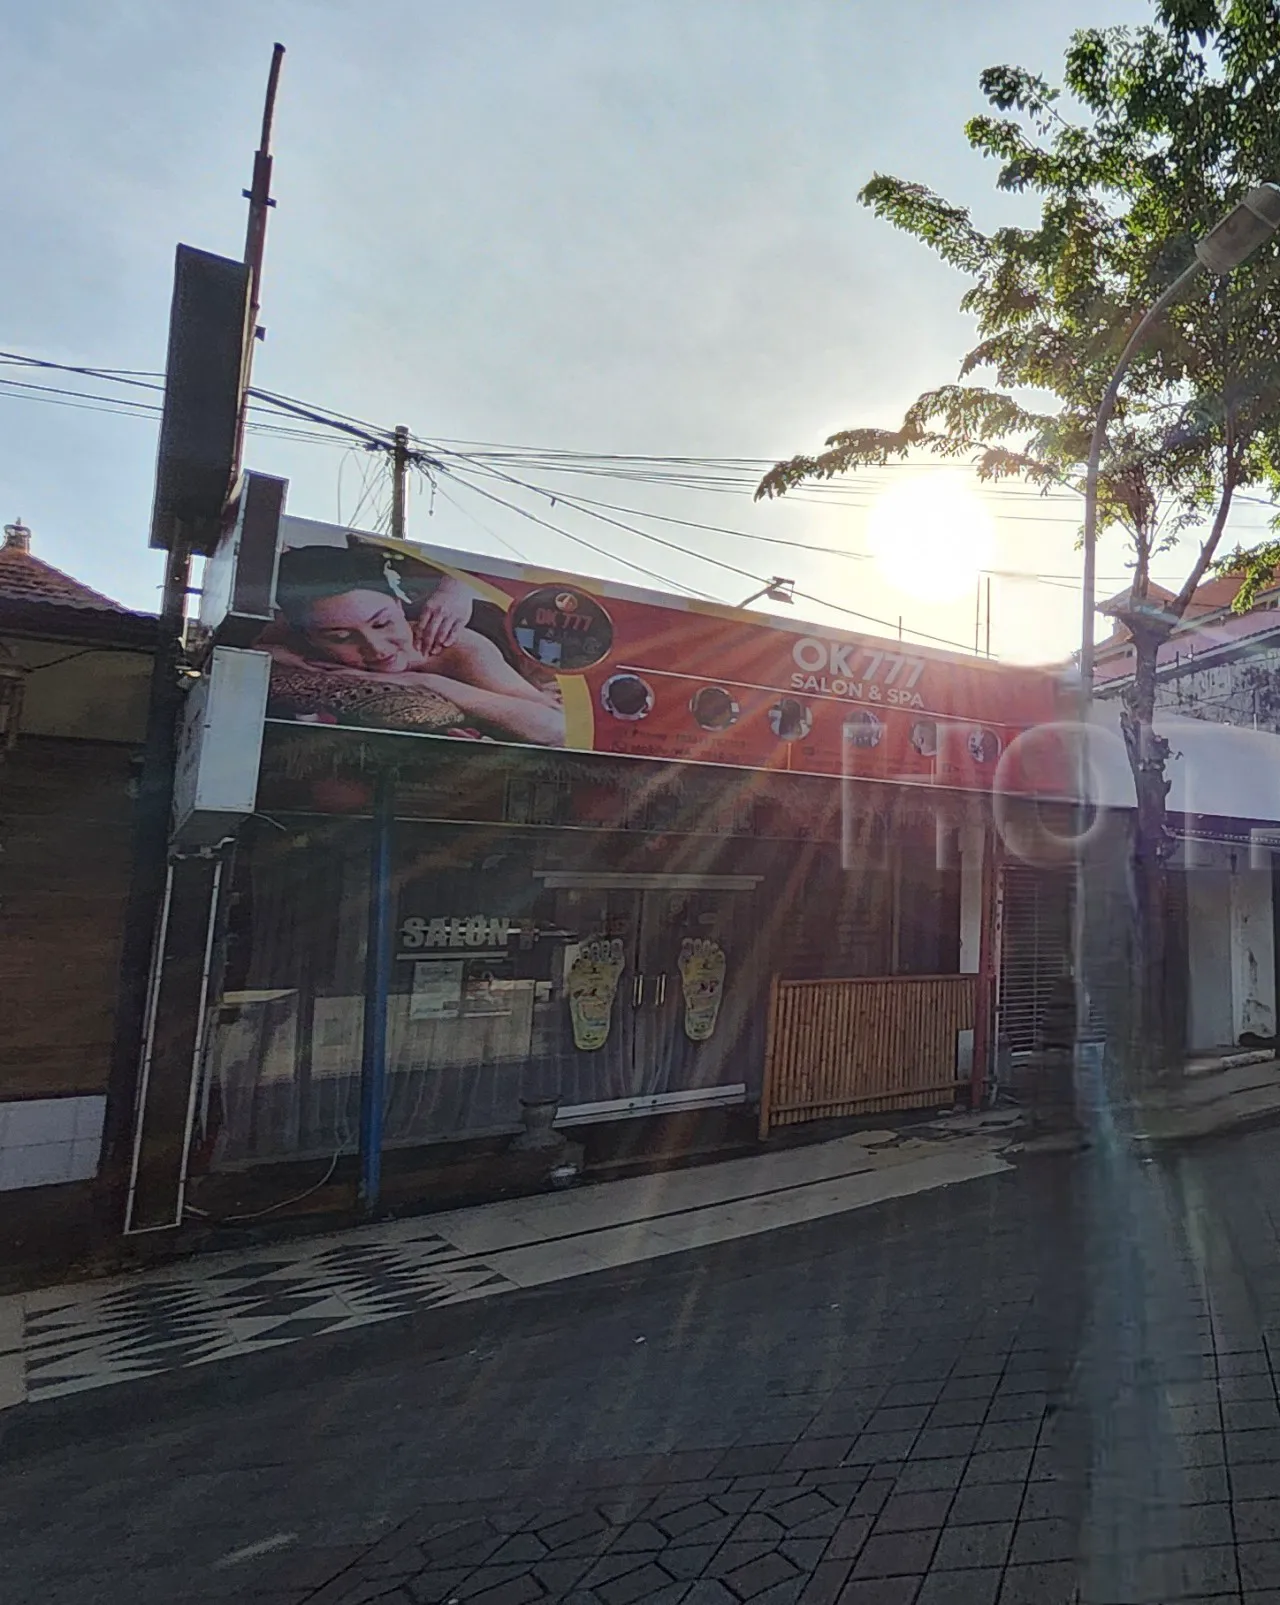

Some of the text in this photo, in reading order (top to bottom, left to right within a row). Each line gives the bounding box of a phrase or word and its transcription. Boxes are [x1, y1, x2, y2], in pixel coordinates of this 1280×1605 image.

[792, 638, 926, 689] OK 777
[791, 672, 925, 708] SALON & SPA
[403, 916, 510, 948] SALON
